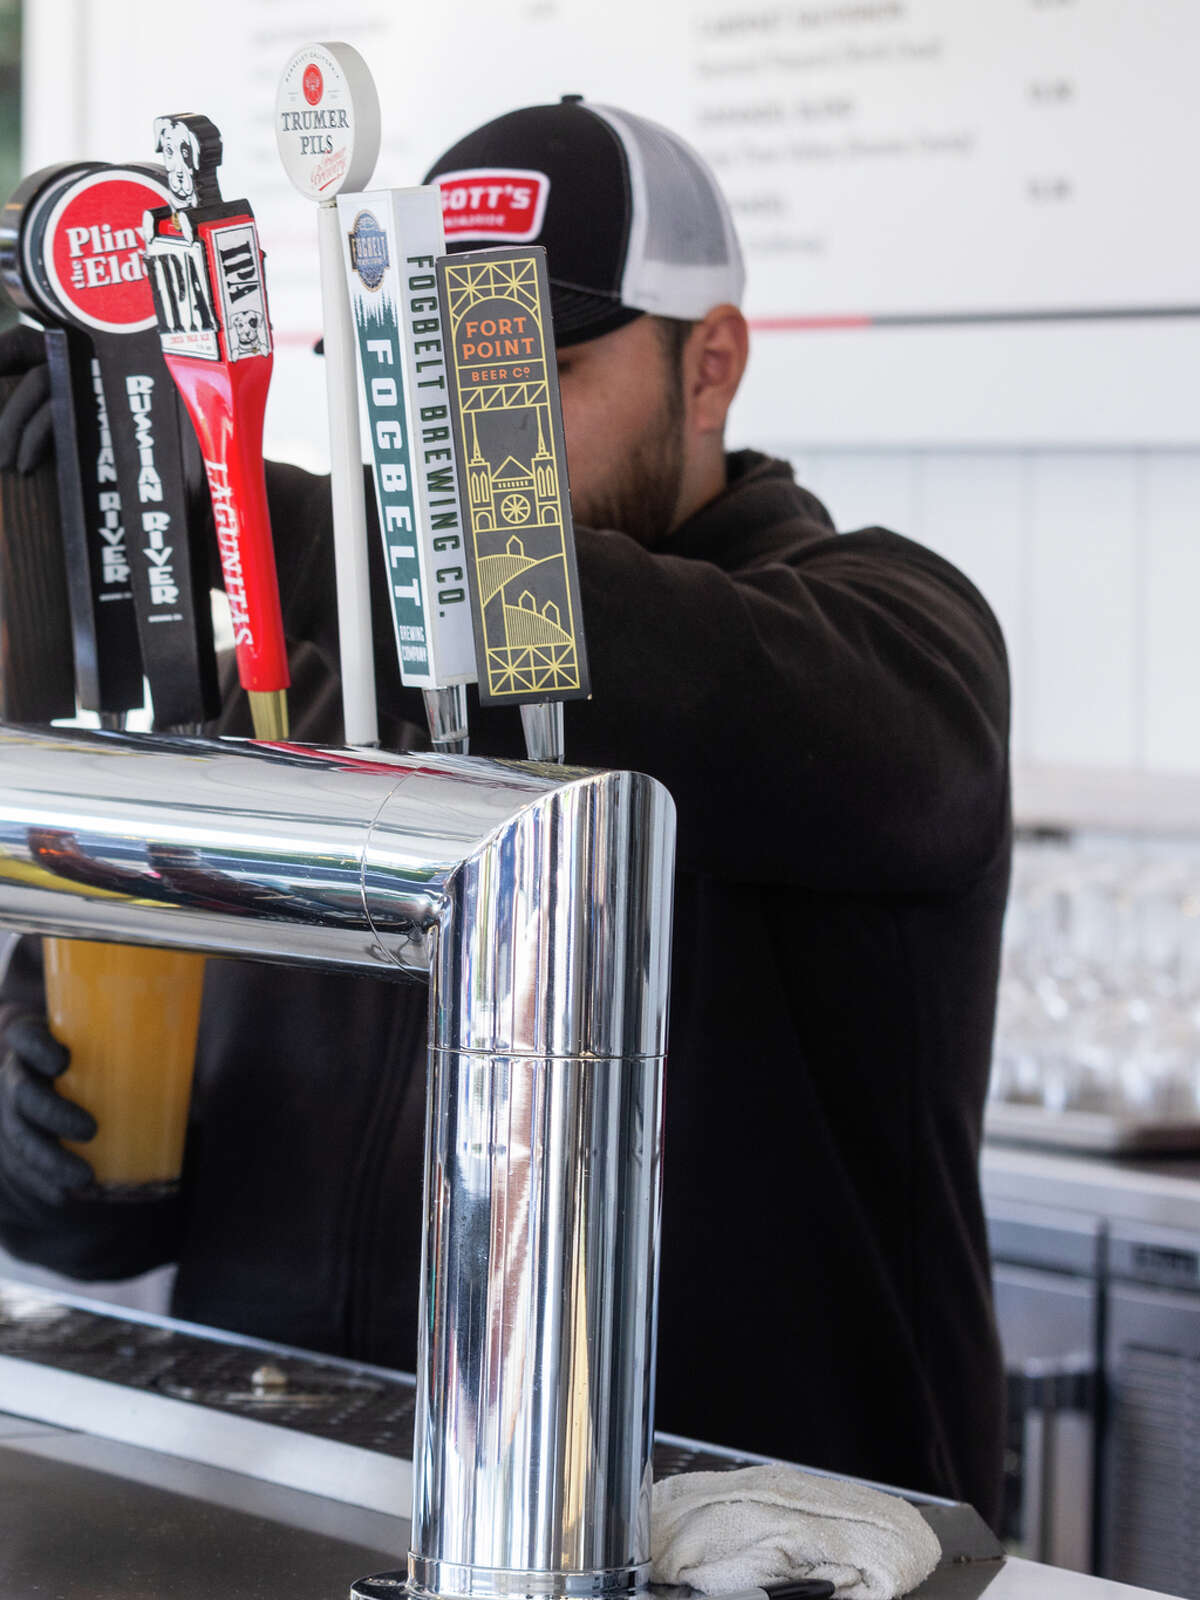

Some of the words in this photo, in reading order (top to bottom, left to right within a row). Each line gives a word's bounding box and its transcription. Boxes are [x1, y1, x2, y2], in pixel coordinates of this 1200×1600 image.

[281, 109, 349, 131] TRUMER
[300, 135, 333, 155] PILS
[84, 248, 151, 288] Eld
[143, 252, 218, 334] IPA
[220, 240, 260, 304] IPA
[407, 255, 445, 391] FOGBELT
[462, 337, 535, 360] POINT
[465, 316, 527, 338] FORT
[471, 369, 508, 382] BEER
[125, 375, 164, 503] RUSSIAN
[366, 339, 422, 608] FOGBELT
[420, 404, 460, 552] BREWING
[99, 491, 131, 584] RIVER
[141, 511, 180, 605] RIVER
[204, 459, 255, 648] LAGUNITAS
